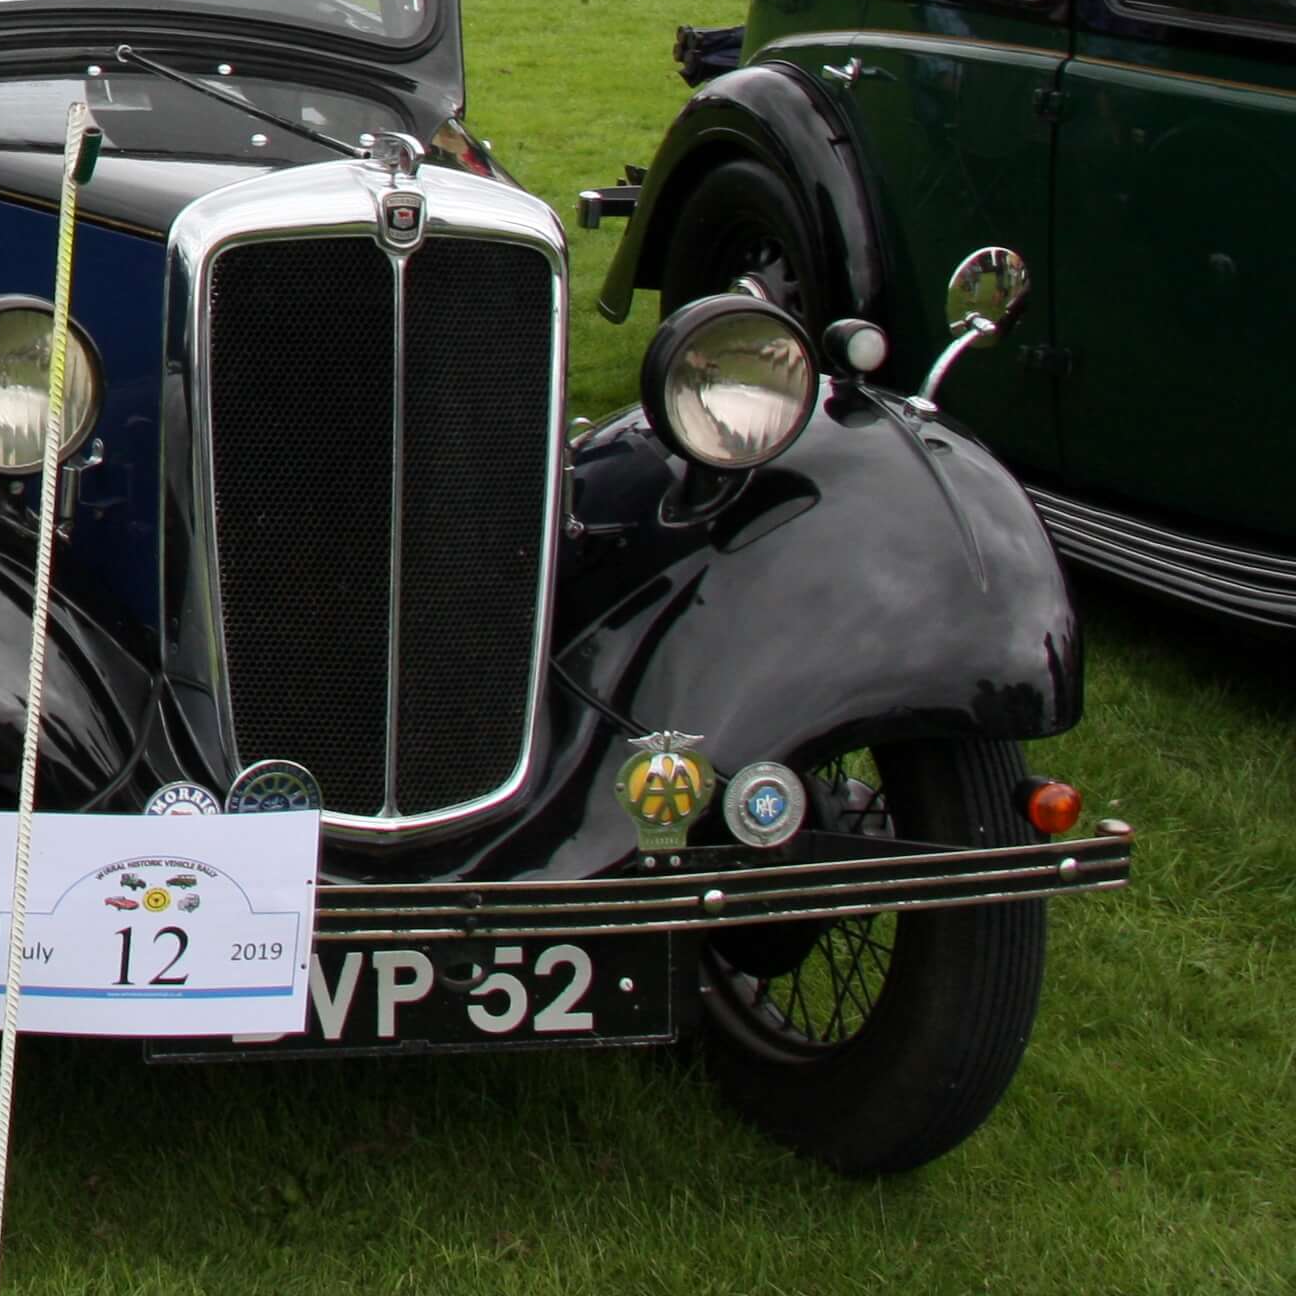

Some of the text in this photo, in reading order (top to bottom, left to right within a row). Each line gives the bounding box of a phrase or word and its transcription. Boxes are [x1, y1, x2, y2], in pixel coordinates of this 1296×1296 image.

[150, 787, 216, 815] MORRIS
[21, 925, 284, 987] uly 12 2019
[466, 943, 595, 1034] 52
